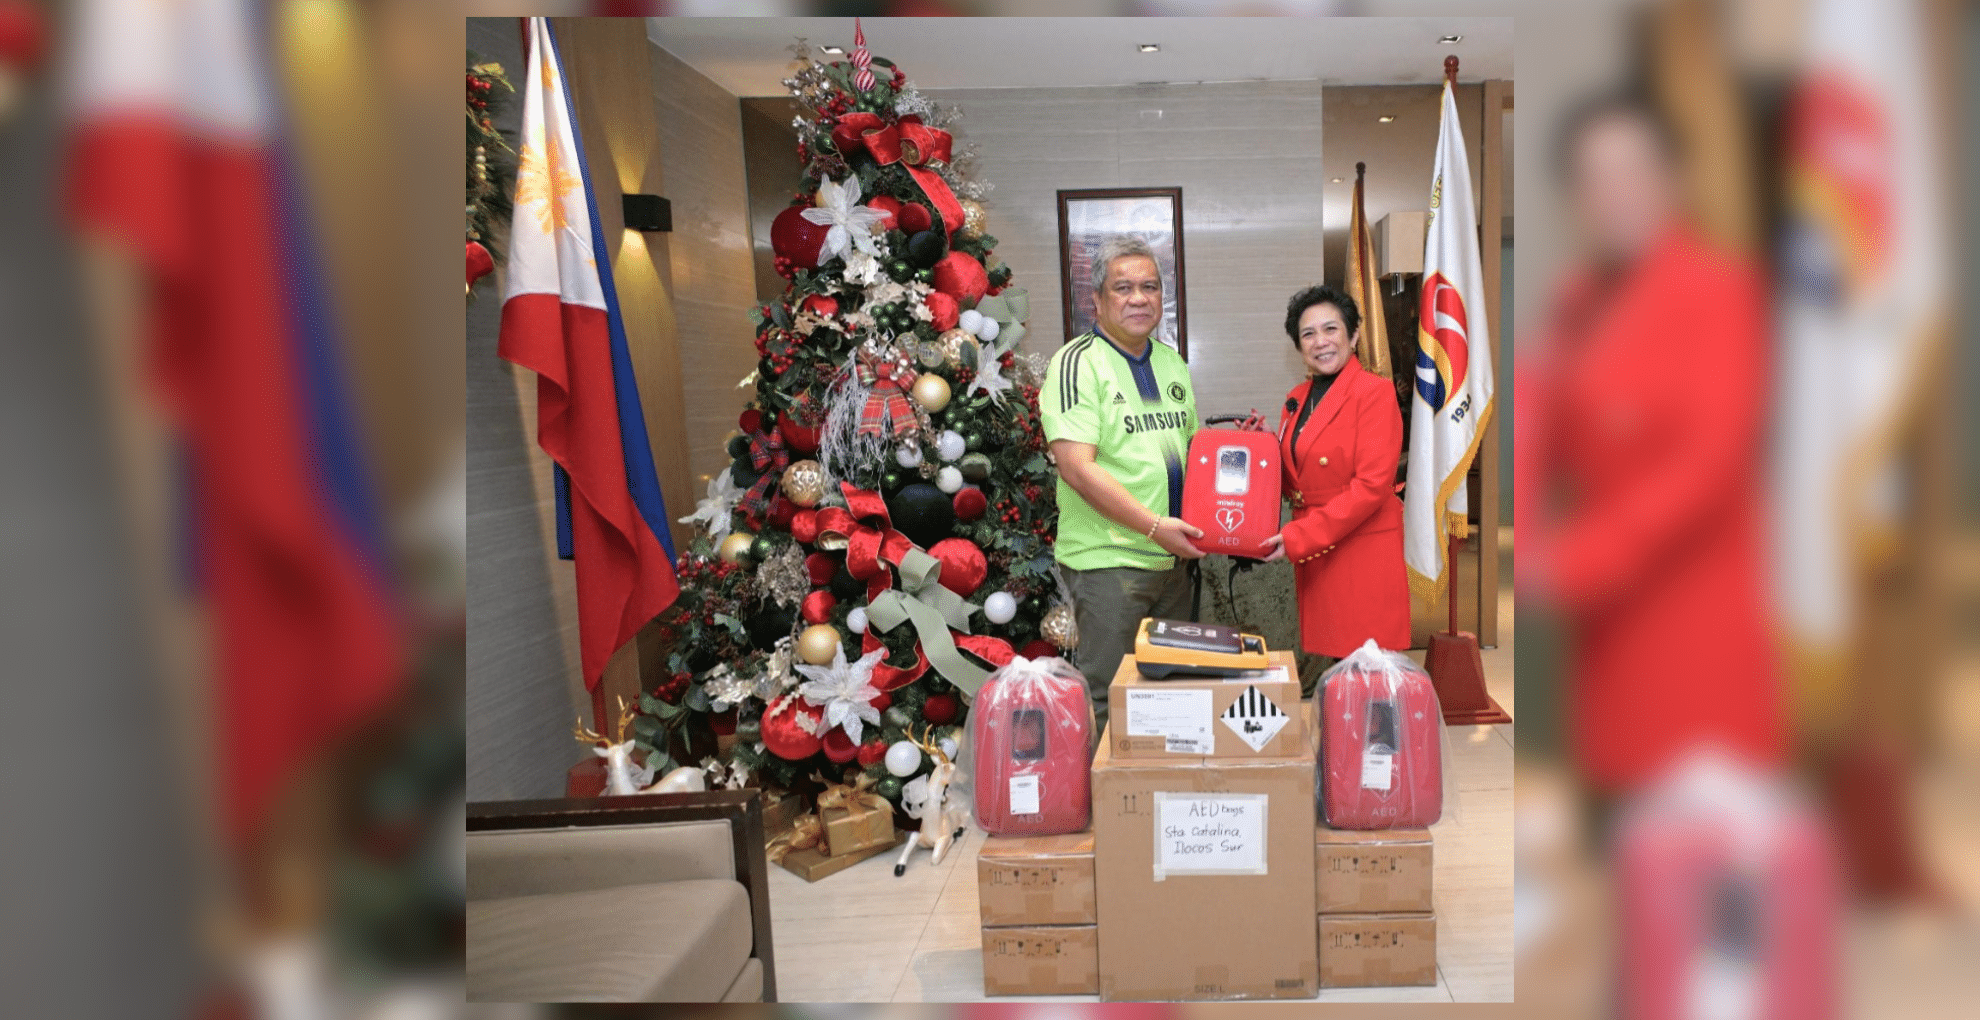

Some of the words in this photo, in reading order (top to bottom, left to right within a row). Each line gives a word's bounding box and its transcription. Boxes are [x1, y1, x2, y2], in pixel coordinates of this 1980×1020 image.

[1218, 537, 1240, 546] AED
[1189, 801, 1219, 818] AED
[1371, 807, 1397, 817] AED
[1165, 825, 1185, 838] Sta
[1174, 840, 1213, 855] Ilocos
[1220, 839, 1244, 852] Sur
